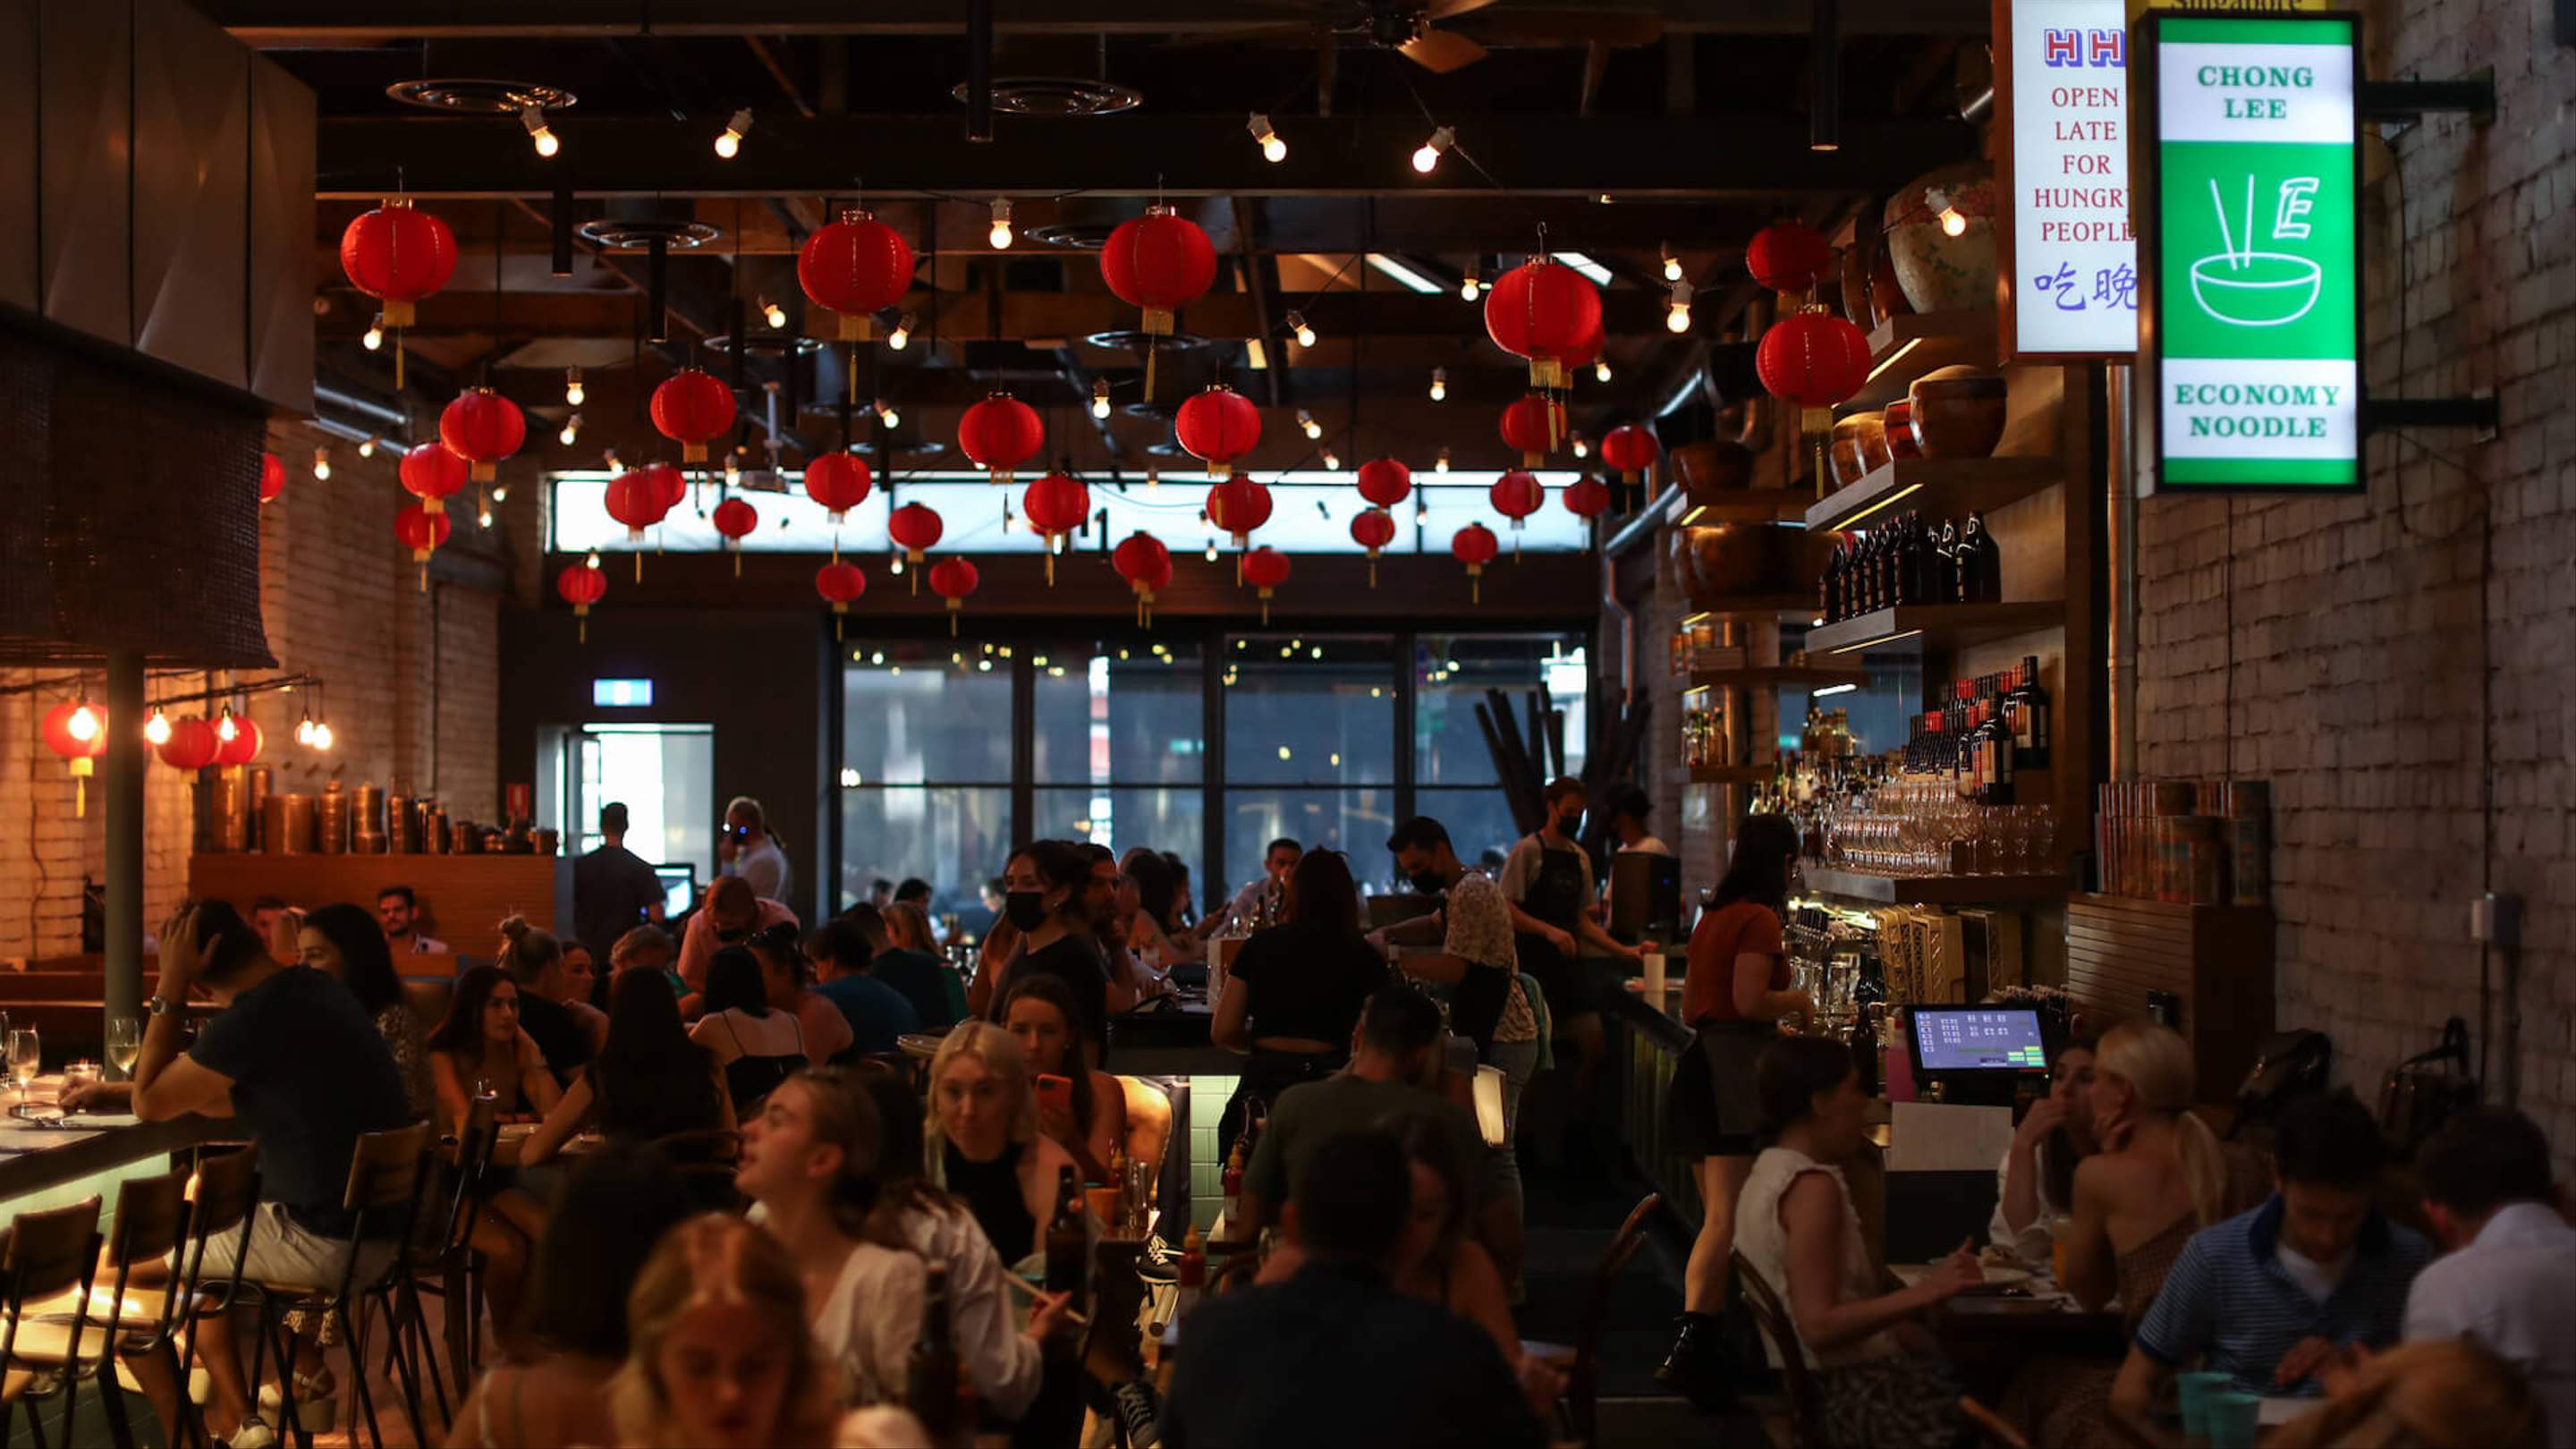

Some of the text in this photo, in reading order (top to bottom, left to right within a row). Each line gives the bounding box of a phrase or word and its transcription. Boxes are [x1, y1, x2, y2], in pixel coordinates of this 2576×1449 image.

[2198, 65, 2314, 87] CHONG
[2051, 88, 2118, 107] OPEN
[2224, 98, 2287, 119] LEE
[2055, 121, 2117, 140] LATE
[2063, 155, 2112, 174] FOR
[2035, 188, 2128, 208] HUNGR
[2042, 221, 2136, 242] PEOPLE
[2174, 384, 2341, 406] ECONOMY
[2190, 416, 2326, 437] NOODLE
